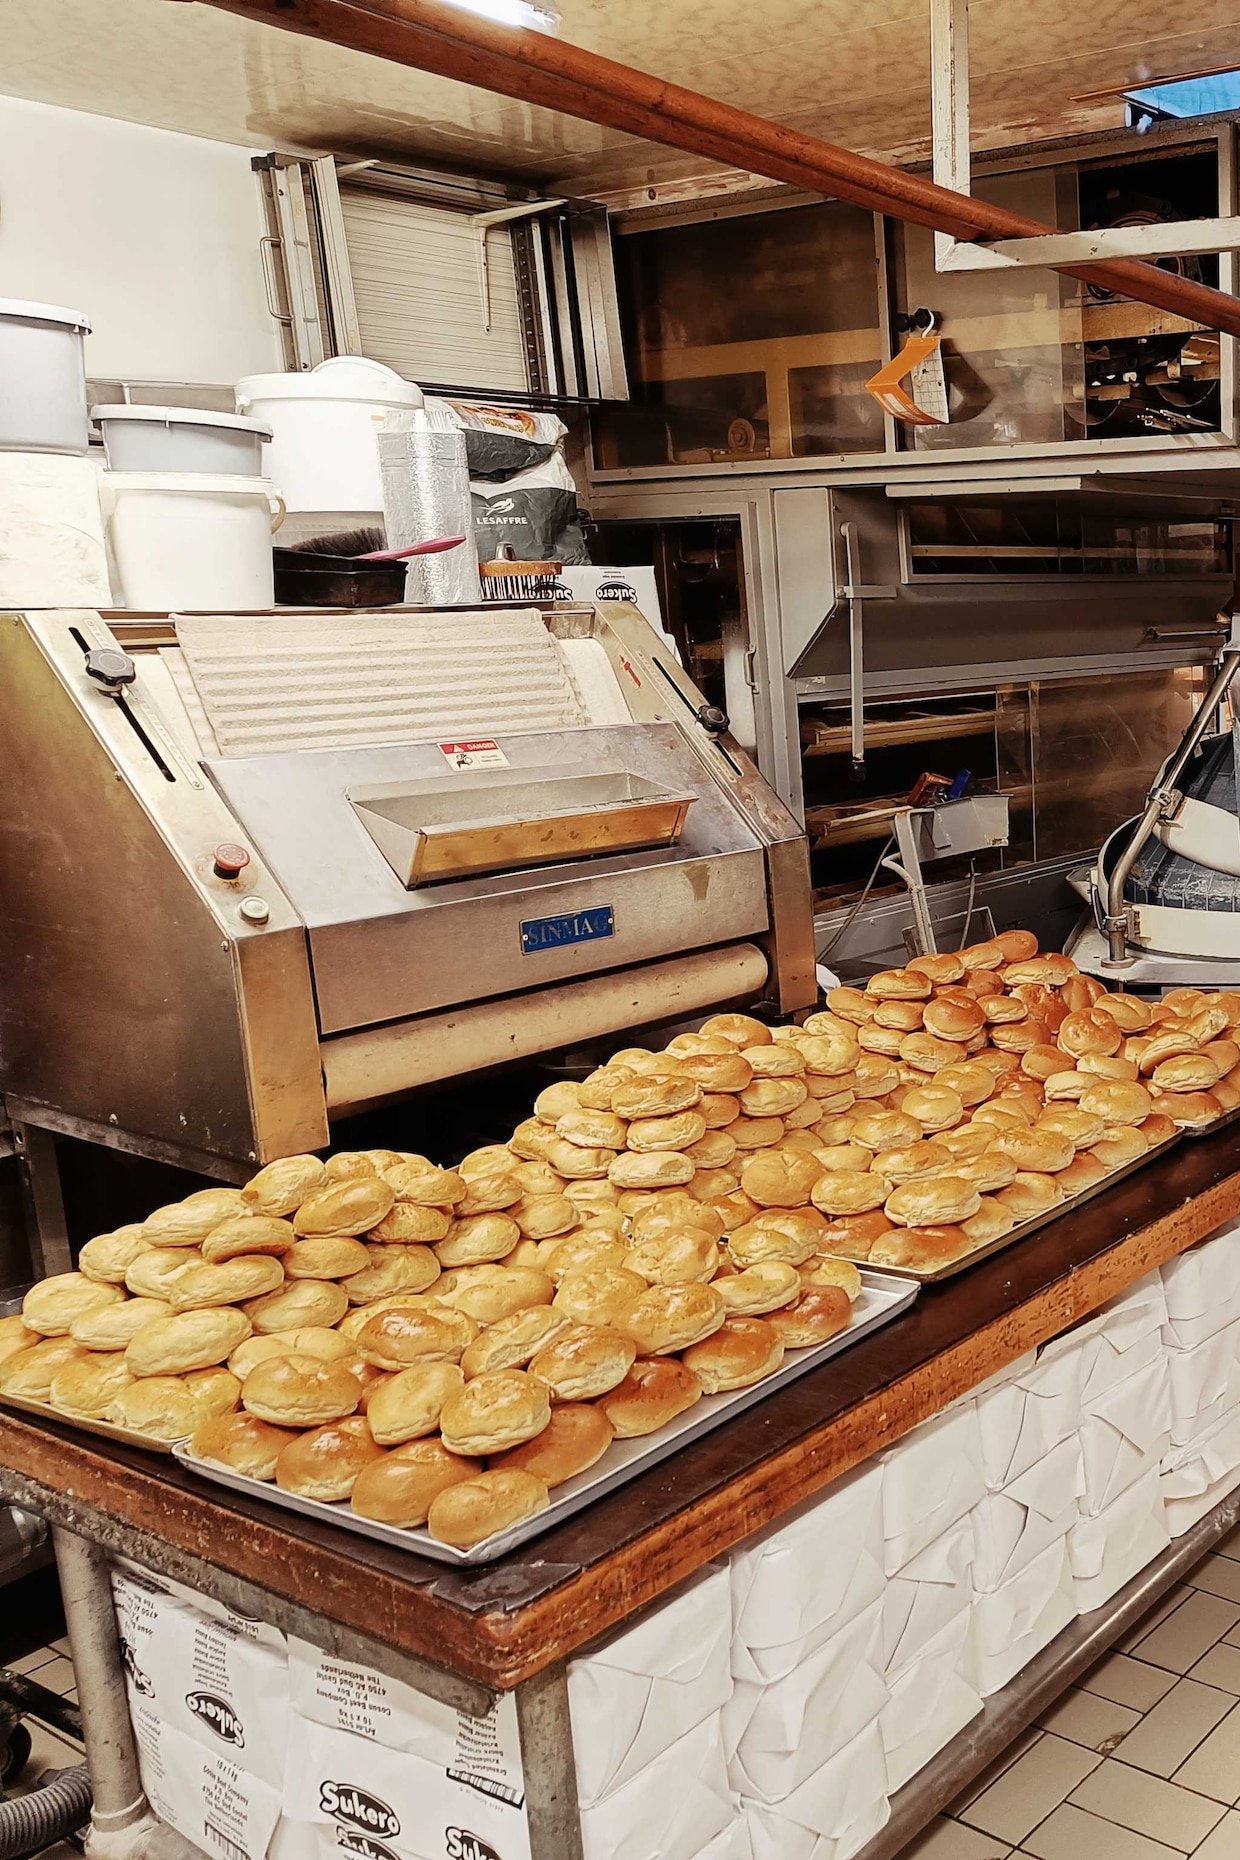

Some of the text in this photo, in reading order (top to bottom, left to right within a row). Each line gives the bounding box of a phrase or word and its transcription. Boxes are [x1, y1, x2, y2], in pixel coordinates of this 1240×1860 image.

[476, 516, 528, 525] LESAFFRE
[596, 588, 638, 603] Sukero
[466, 742, 496, 751] DANGER
[528, 914, 608, 946] SINMAG
[320, 1663, 381, 1685] The Netherlands
[316, 1688, 348, 1705] Company
[185, 1695, 245, 1748] Sukero
[320, 1781, 400, 1836] Sukero
